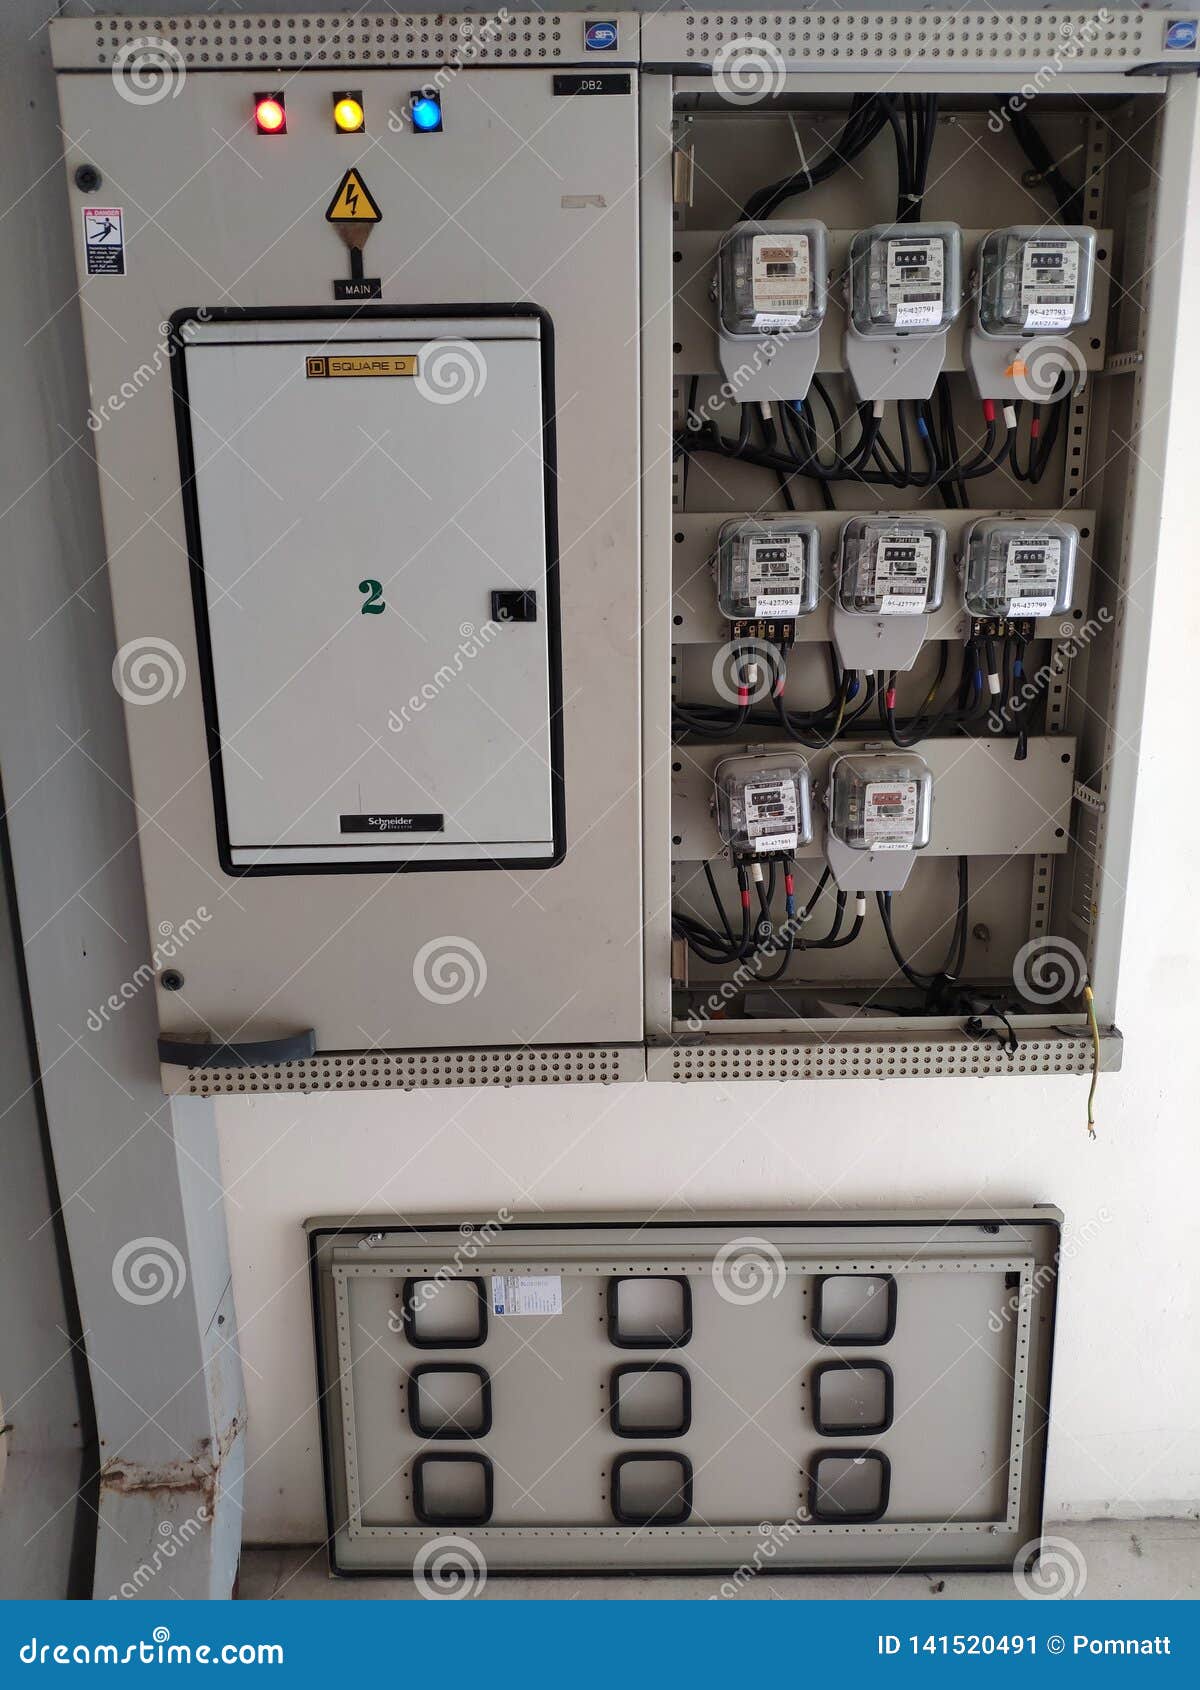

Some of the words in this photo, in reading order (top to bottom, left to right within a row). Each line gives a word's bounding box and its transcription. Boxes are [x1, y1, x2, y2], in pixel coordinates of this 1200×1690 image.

[581, 80, 603, 90] DB2
[345, 285, 371, 295] MAIN
[332, 361, 390, 372] SQUARE
[395, 361, 406, 371] D
[359, 579, 385, 615] 2
[368, 816, 413, 832] Schneider
